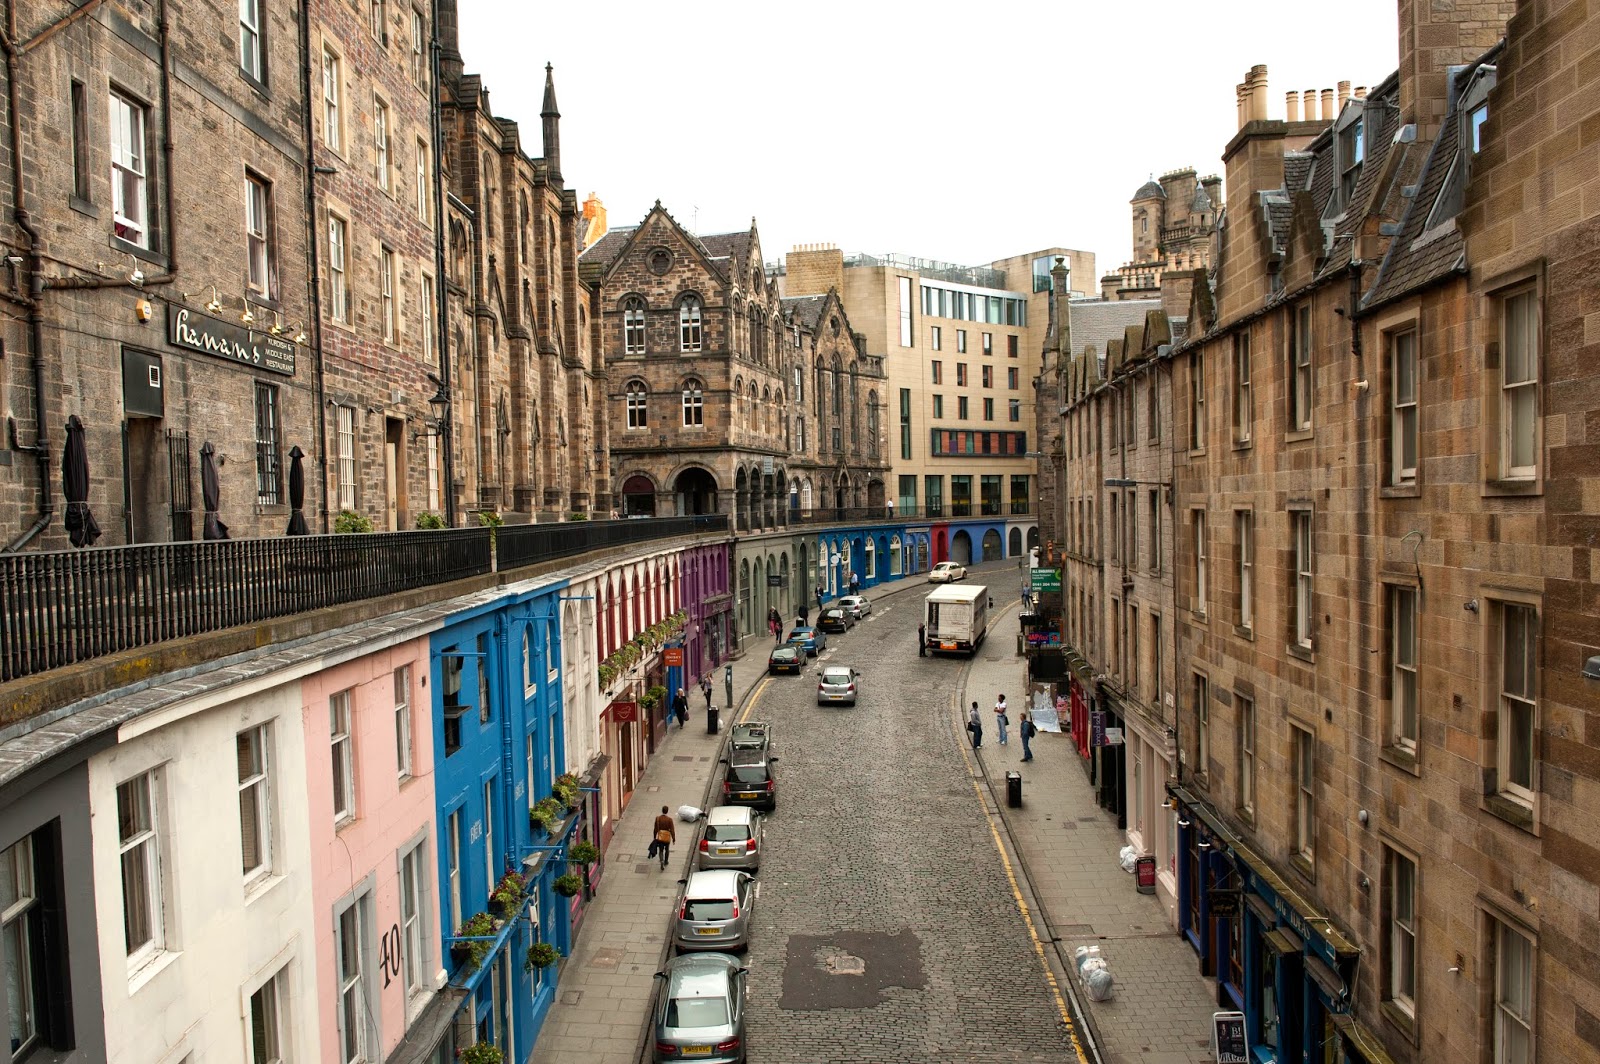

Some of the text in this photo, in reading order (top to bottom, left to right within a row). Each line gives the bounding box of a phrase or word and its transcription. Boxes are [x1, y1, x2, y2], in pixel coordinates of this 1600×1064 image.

[265, 348, 294, 362] MIDDLE EAST
[266, 359, 294, 373] RESTAURANT
[380, 923, 400, 990] 40
